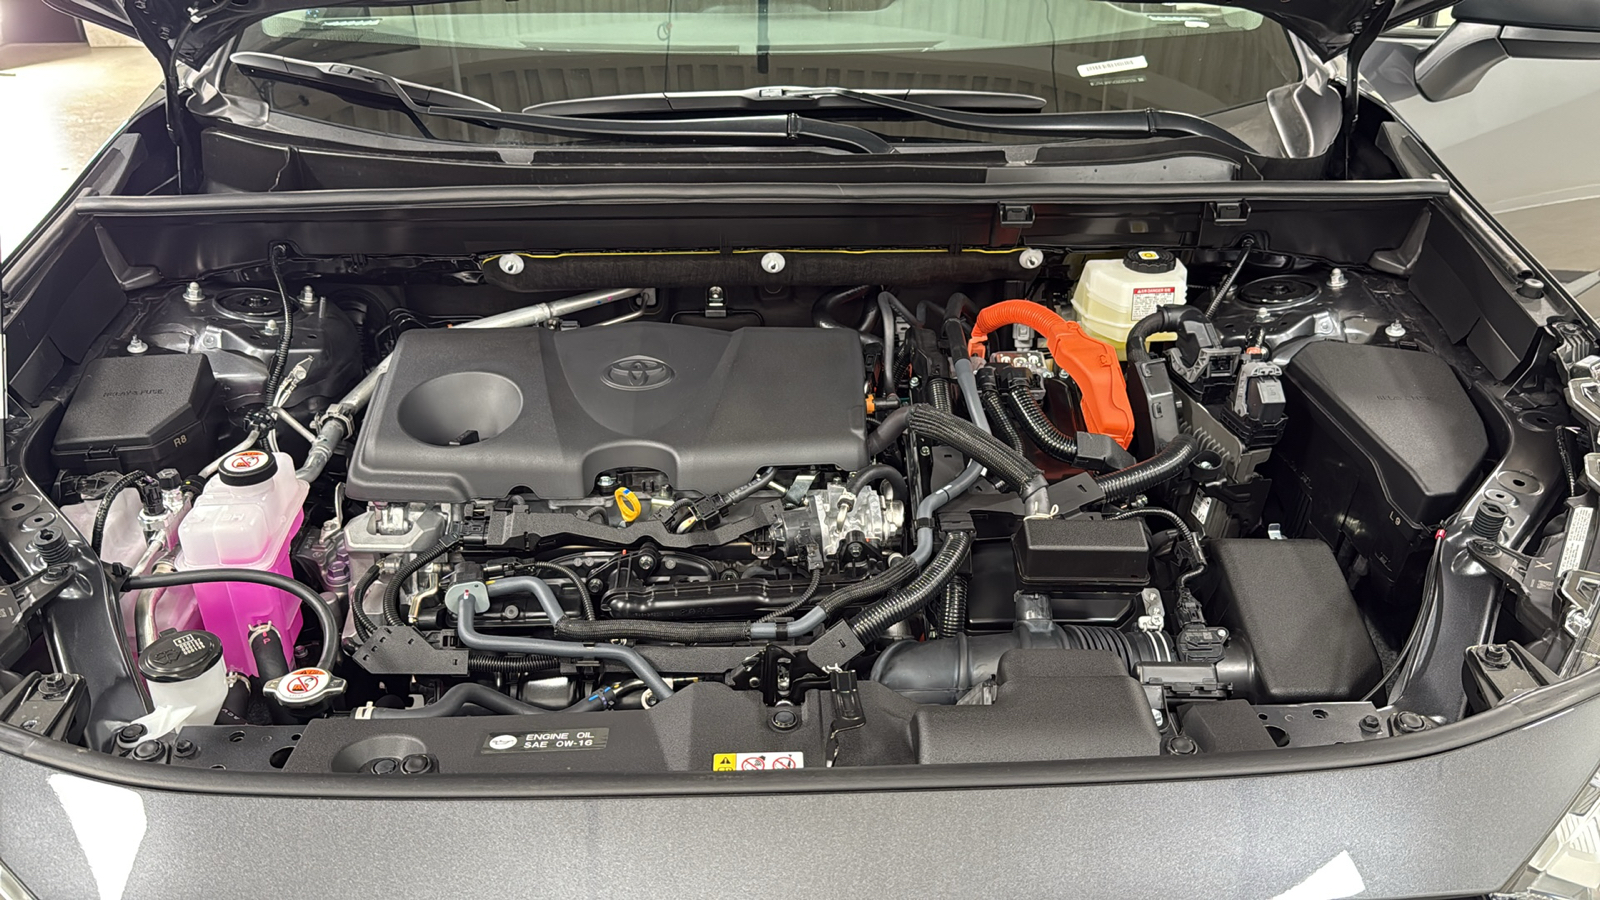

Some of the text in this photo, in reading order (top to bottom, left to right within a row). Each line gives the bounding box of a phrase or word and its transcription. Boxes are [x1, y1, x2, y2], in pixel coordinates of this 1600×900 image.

[173, 434, 188, 448] R8
[526, 731, 595, 741] ENGINE OIL
[523, 739, 593, 749] SAE 0W-16
